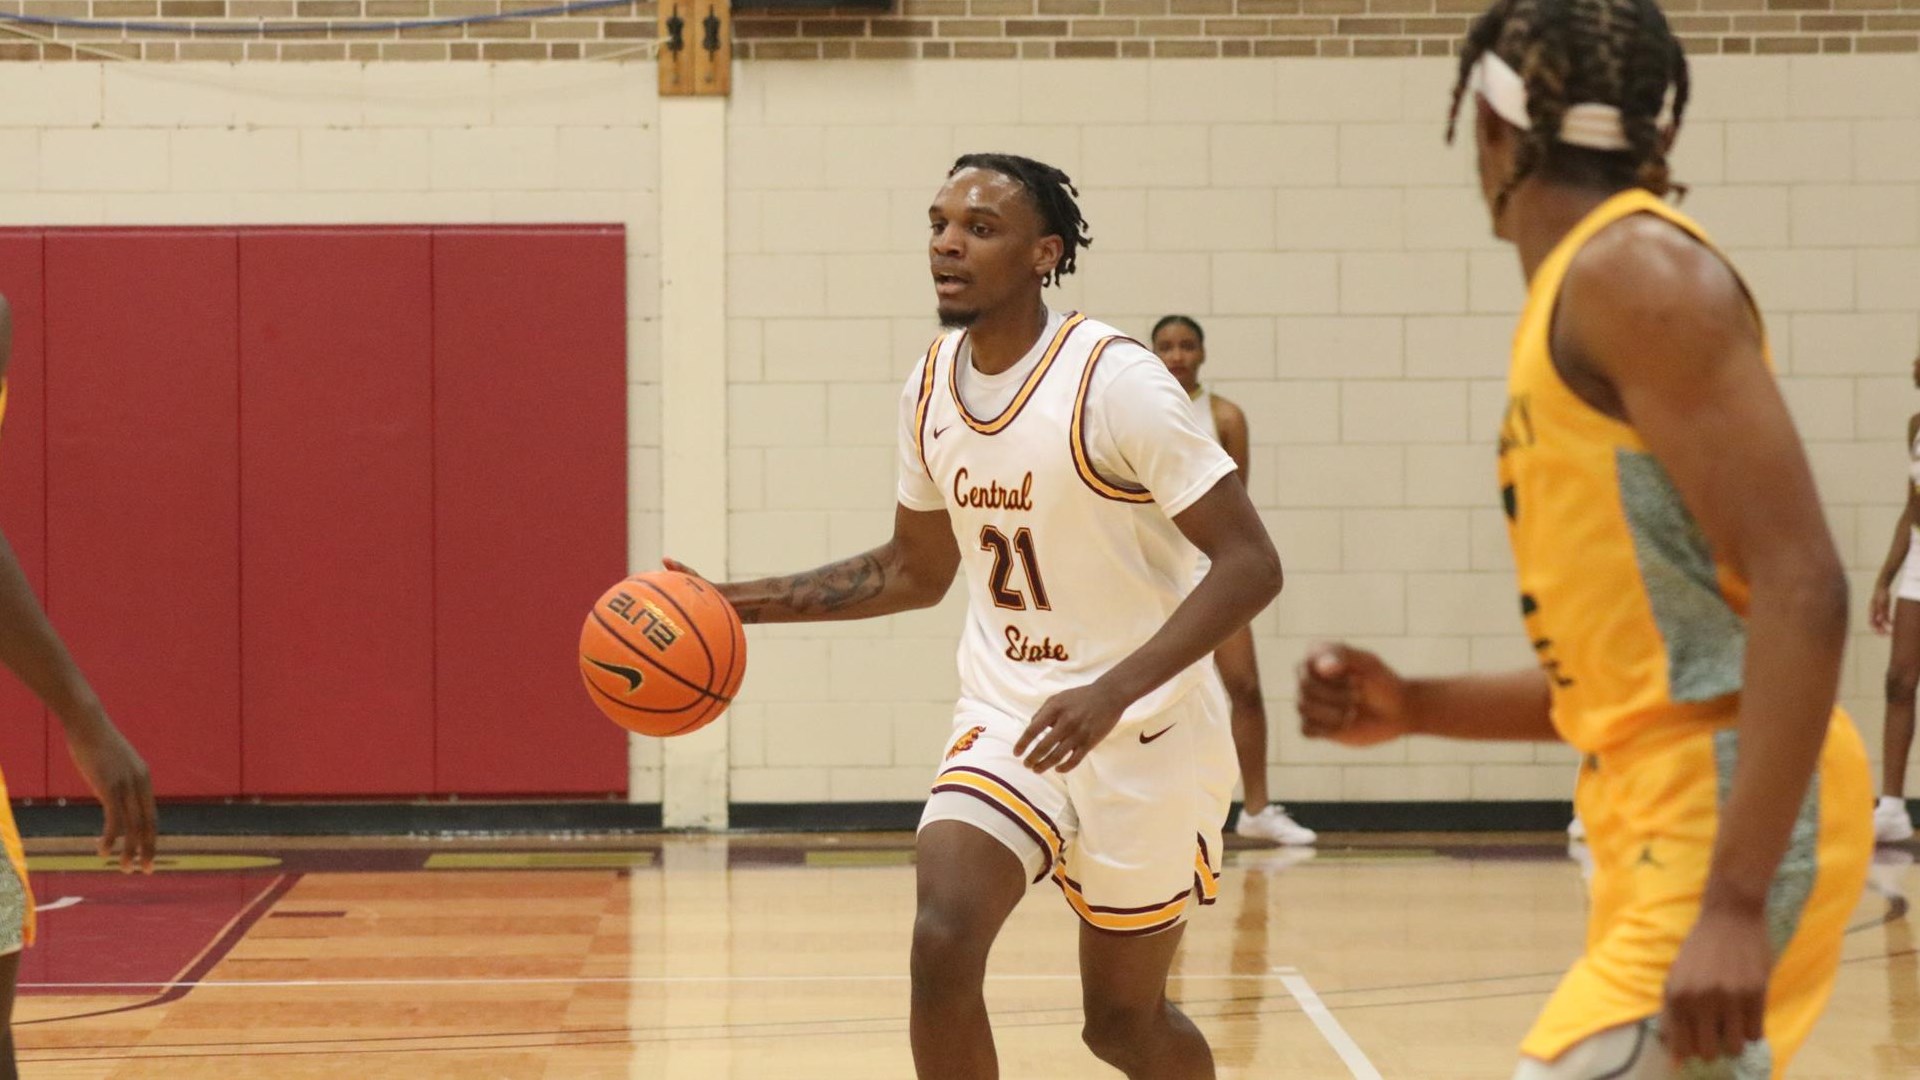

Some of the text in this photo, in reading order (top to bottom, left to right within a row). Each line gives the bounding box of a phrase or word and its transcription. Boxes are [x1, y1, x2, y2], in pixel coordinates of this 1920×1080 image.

[954, 467, 1033, 511] Central
[980, 525, 1052, 611] 21
[607, 592, 677, 652] ELITE
[1004, 625, 1069, 662] State
